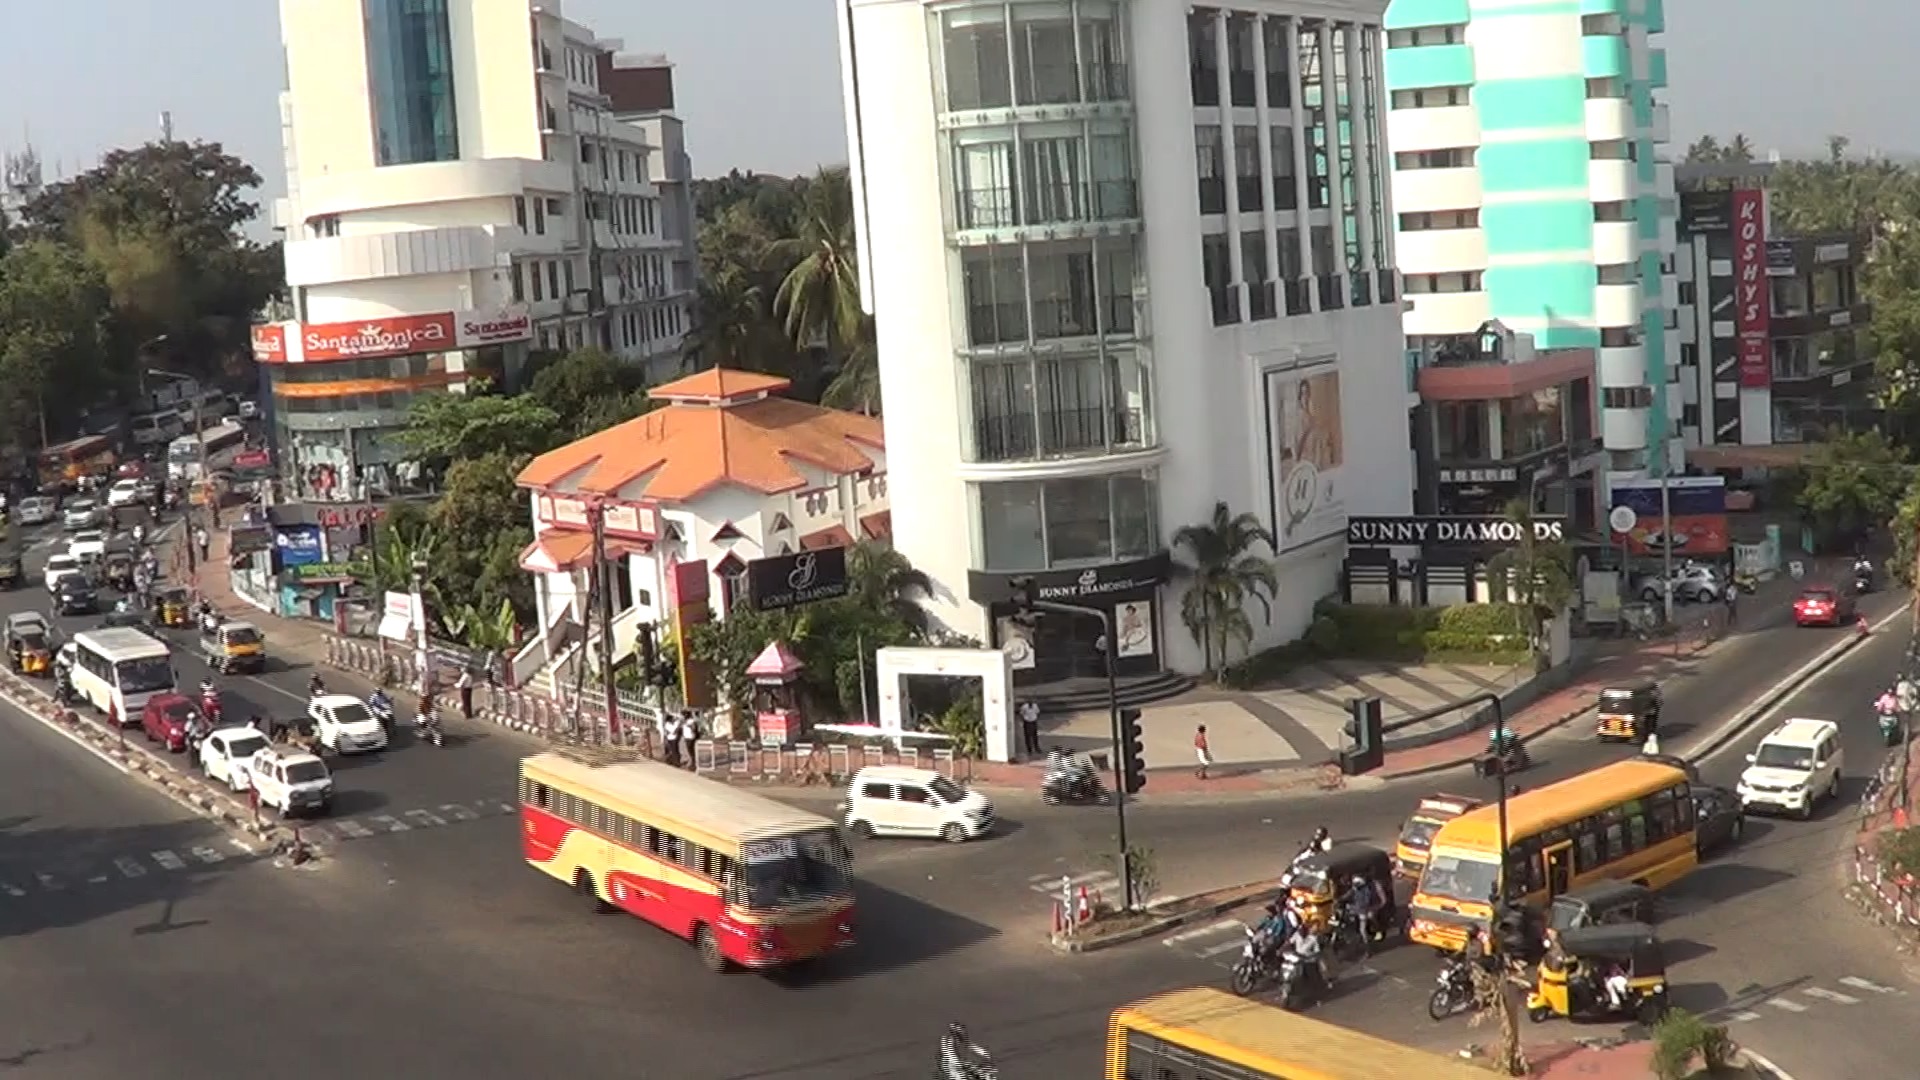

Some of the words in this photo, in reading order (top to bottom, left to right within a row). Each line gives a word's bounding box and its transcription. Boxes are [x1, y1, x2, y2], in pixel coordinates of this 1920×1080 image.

[1740, 201, 1760, 322] KOSHYS
[306, 322, 446, 350] Santamonica
[1350, 521, 1428, 540] SUNNY
[1437, 521, 1563, 541] DIAMONDS
